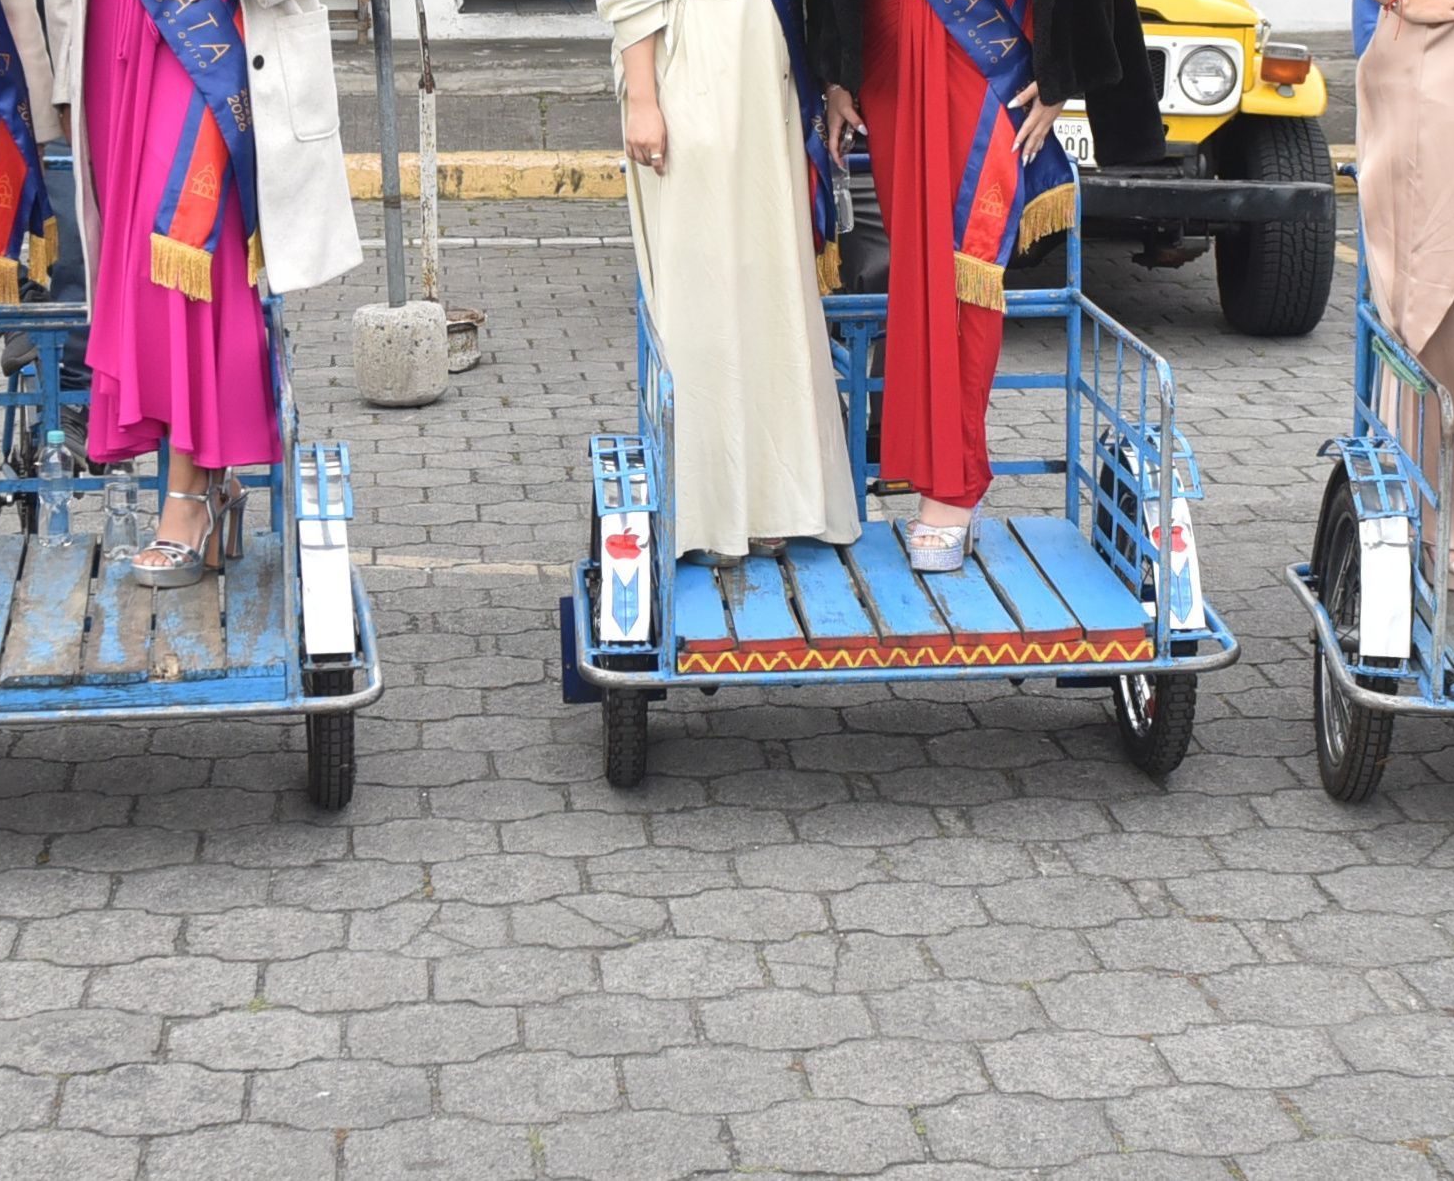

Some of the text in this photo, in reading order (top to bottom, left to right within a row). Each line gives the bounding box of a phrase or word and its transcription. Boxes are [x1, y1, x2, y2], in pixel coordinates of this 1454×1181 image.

[176, 30, 207, 70] QUITO
[967, 28, 999, 65] QUITO
[226, 94, 247, 132] 2026
